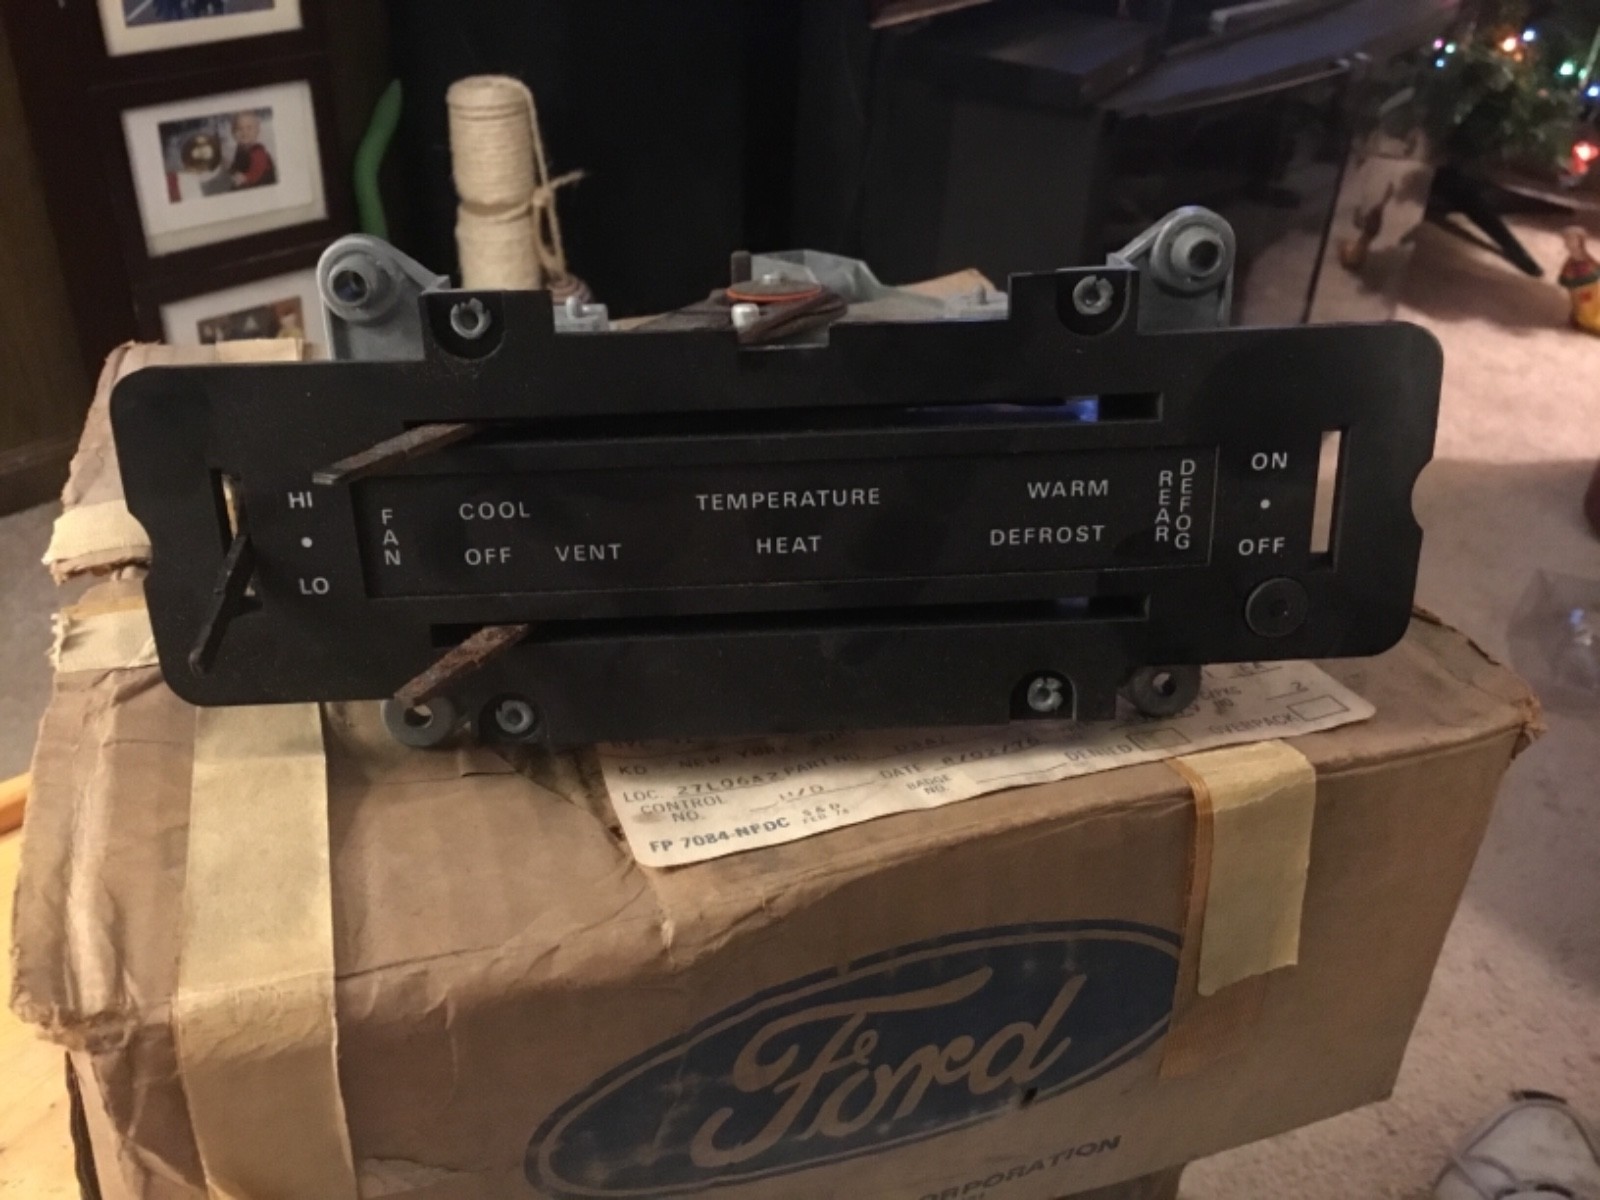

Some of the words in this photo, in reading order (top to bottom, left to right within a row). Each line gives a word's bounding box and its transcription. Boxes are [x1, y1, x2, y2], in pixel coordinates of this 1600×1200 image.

[1251, 451, 1288, 471] ON
[1026, 478, 1110, 499] WARM
[287, 490, 314, 509] HI
[696, 487, 881, 511] TEMPERATURE
[1154, 469, 1173, 543] REAR
[1174, 458, 1196, 550] DEFOG
[458, 501, 531, 520] COOL
[381, 508, 401, 566] FAN
[756, 535, 823, 555] HEAT
[989, 524, 1106, 547] DEFROST
[554, 543, 623, 563] VENT
[1237, 536, 1286, 556] OFF
[463, 547, 512, 566] OFF
[298, 576, 330, 595] LO
[1207, 712, 1293, 734] OVERPACK
[1063, 744, 1133, 762] DENIED
[783, 757, 828, 776] PART
[878, 763, 922, 781] DATE
[905, 773, 951, 792] BADGE
[640, 795, 729, 816] CONTROL
[649, 840, 673, 852] FP
[689, 965, 1088, 1168] Ford
